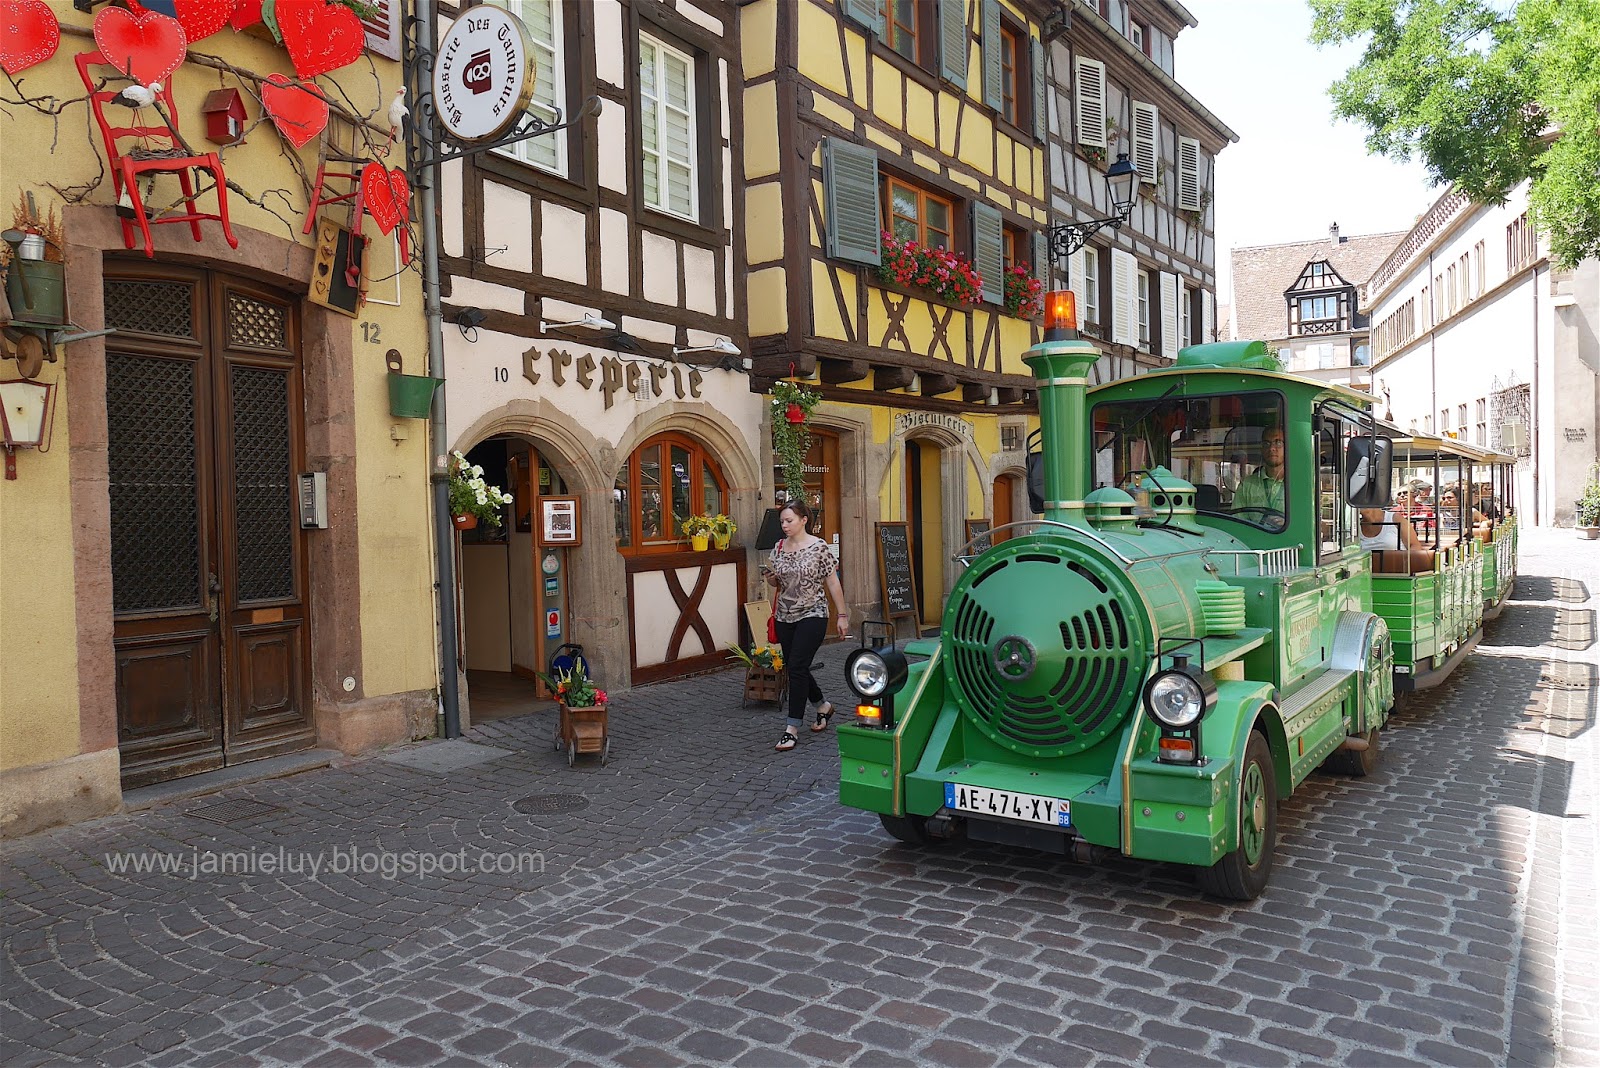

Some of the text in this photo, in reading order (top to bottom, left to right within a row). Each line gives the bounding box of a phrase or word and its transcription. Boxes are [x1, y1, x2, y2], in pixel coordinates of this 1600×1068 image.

[441, 18, 516, 128] Brasserie des Tanneurs
[360, 321, 381, 344] 12
[495, 366, 509, 383] 10
[960, 788, 1053, 821] AE-474-XY
[1059, 814, 1069, 825] 68
